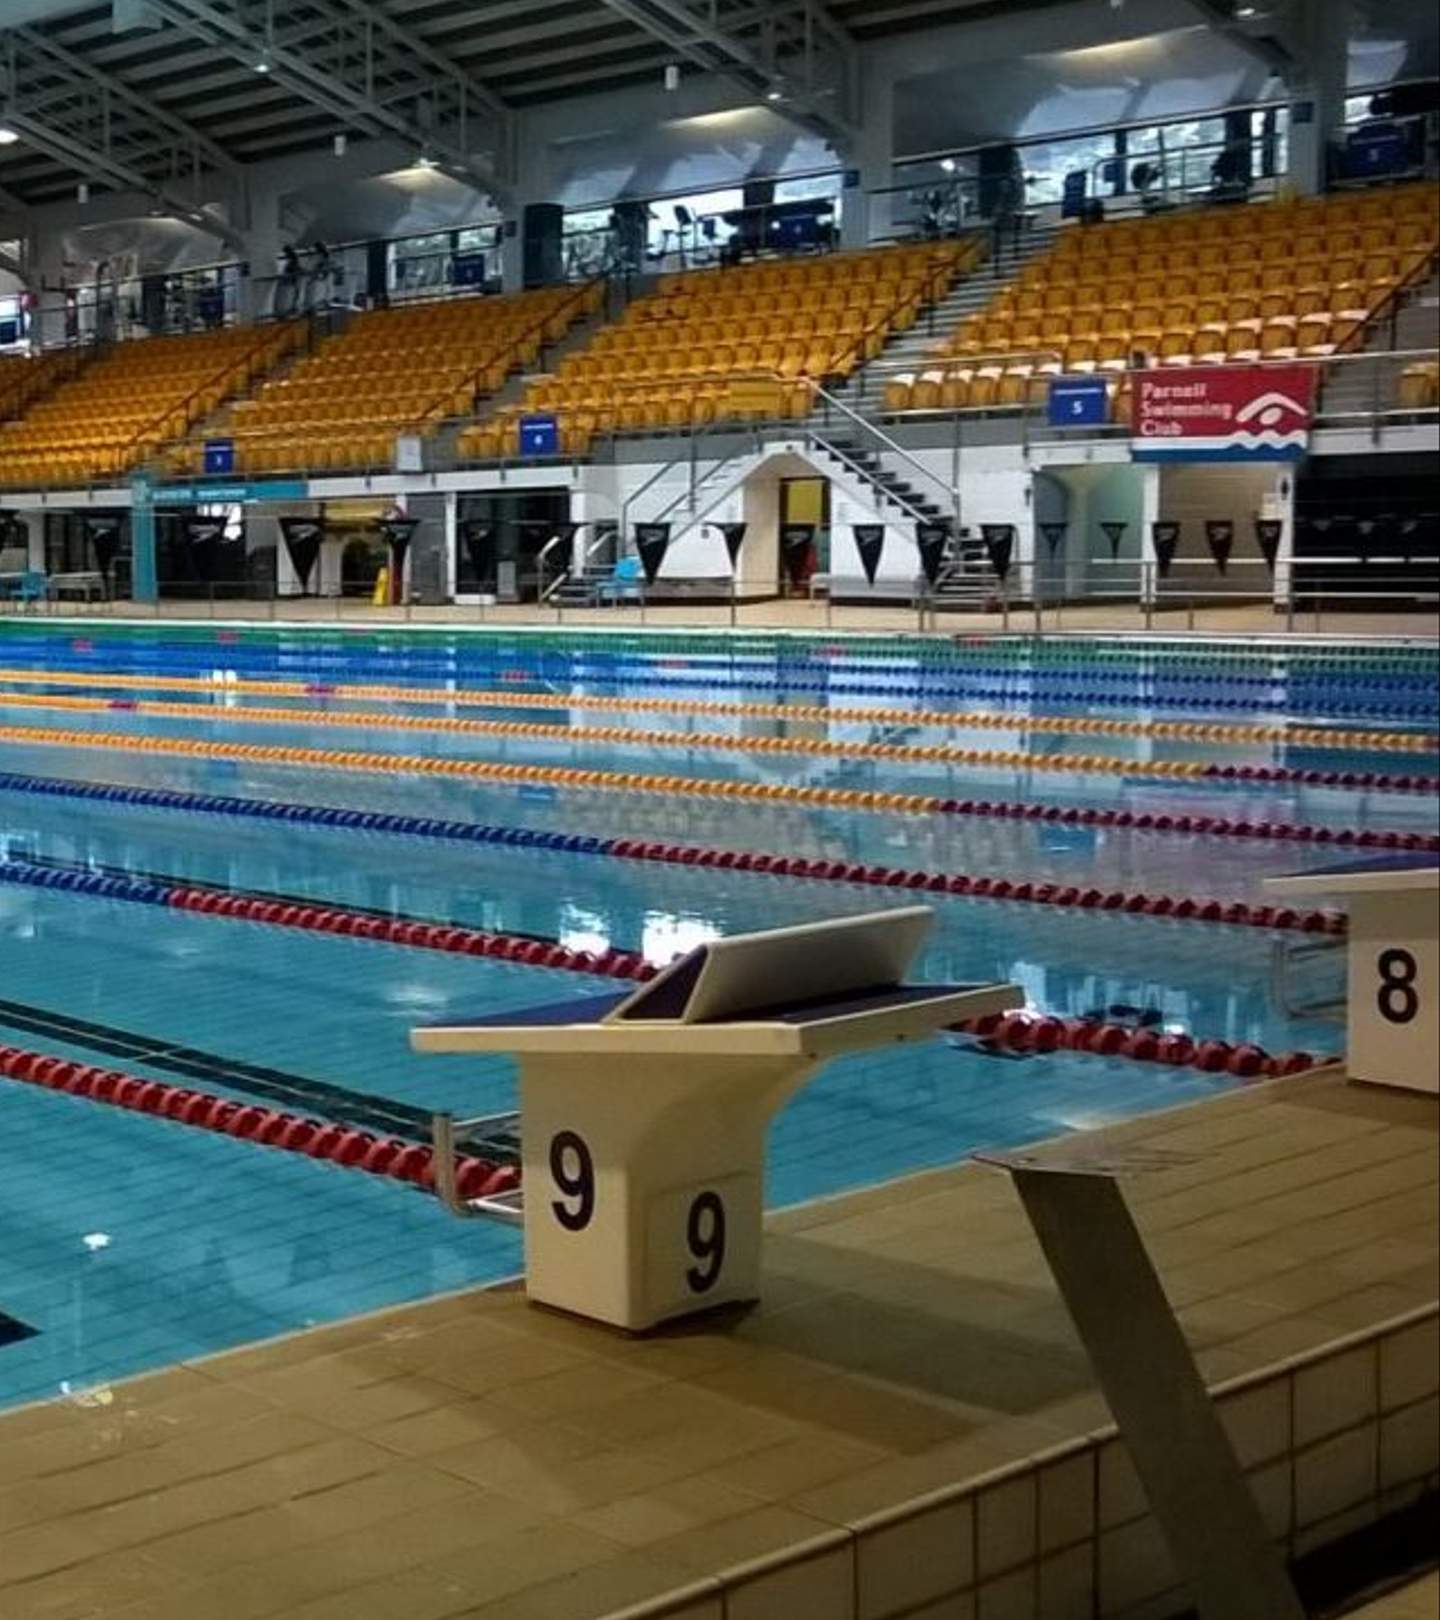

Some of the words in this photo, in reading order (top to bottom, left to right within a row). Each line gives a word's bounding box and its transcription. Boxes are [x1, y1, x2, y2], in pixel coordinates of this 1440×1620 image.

[1140, 401, 1233, 420] Swimming
[1140, 420, 1183, 436] Club
[1377, 948, 1419, 1024] 8
[550, 1130, 594, 1232] 9
[686, 1191, 726, 1293] 9
